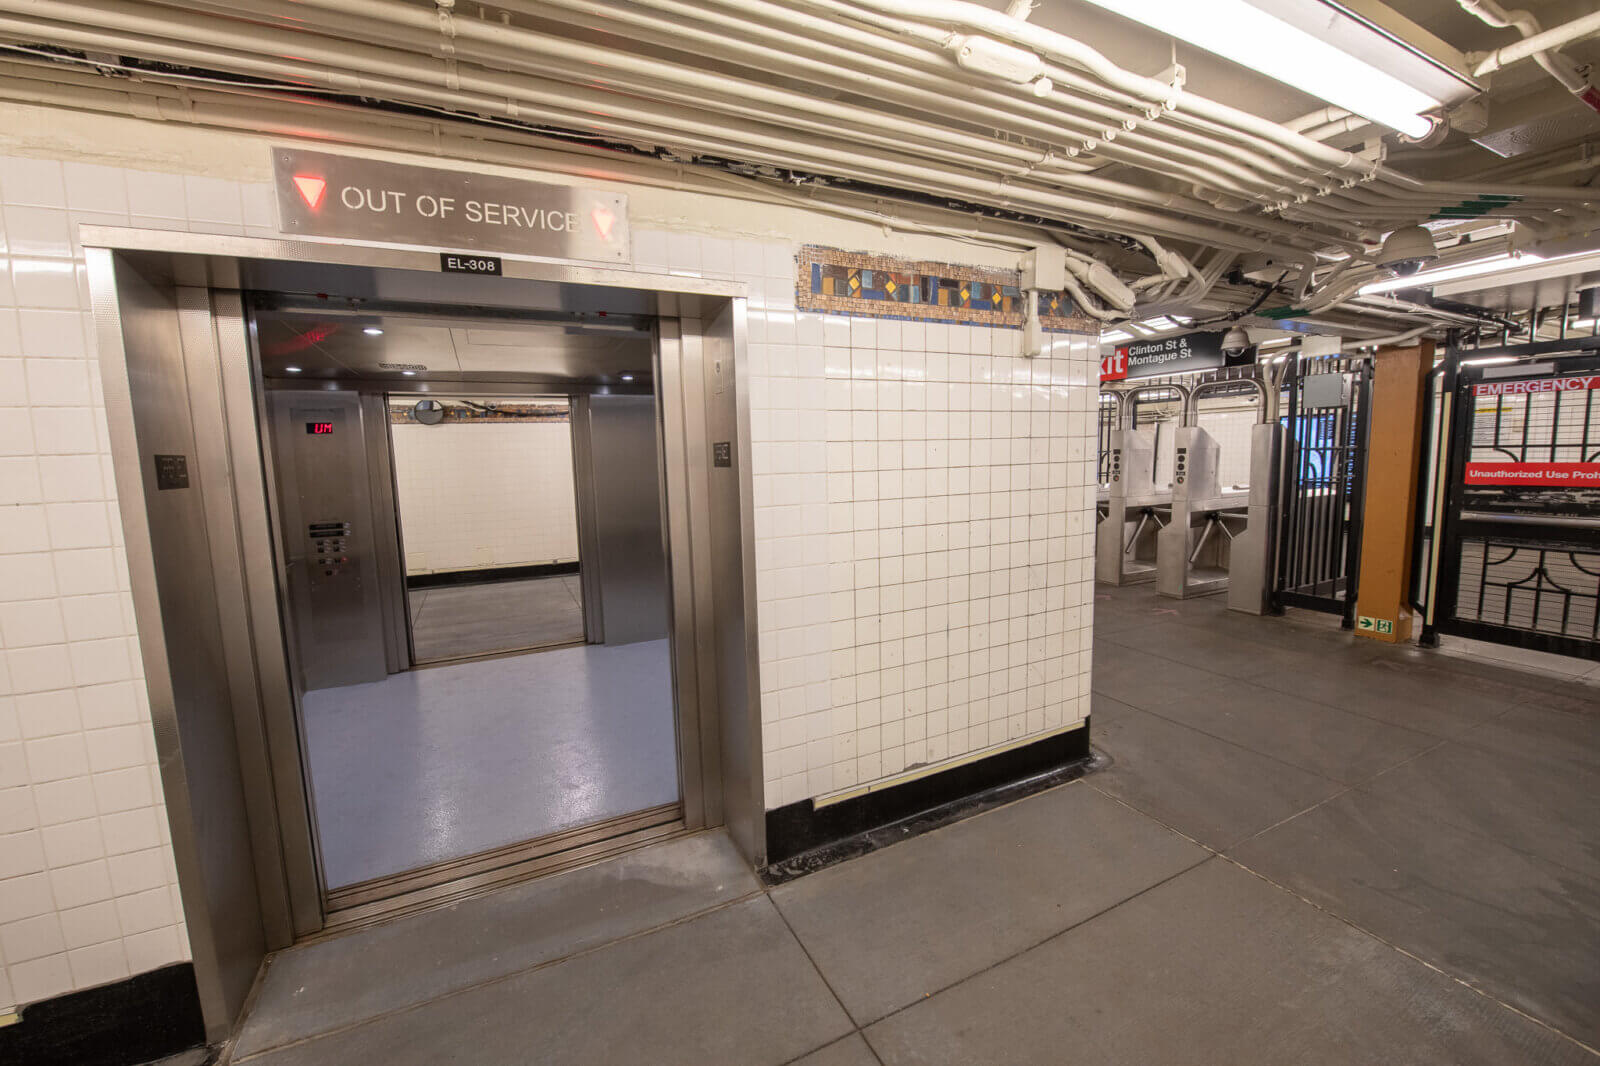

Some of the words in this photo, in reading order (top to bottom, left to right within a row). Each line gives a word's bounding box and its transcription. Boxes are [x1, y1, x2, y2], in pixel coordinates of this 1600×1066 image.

[341, 185, 406, 214] OUT
[416, 195, 455, 219] OF
[465, 201, 582, 233] SERVICE
[447, 257, 496, 272] EL-308
[1128, 343, 1163, 356] Clinton
[1165, 339, 1177, 350] St
[1179, 338, 1188, 348] &
[1128, 351, 1177, 366] Montague
[1180, 348, 1192, 359] St
[1476, 377, 1593, 396] EMERGENCY
[1469, 470, 1542, 479] Unauthorized
[1545, 471, 1569, 479] Use
